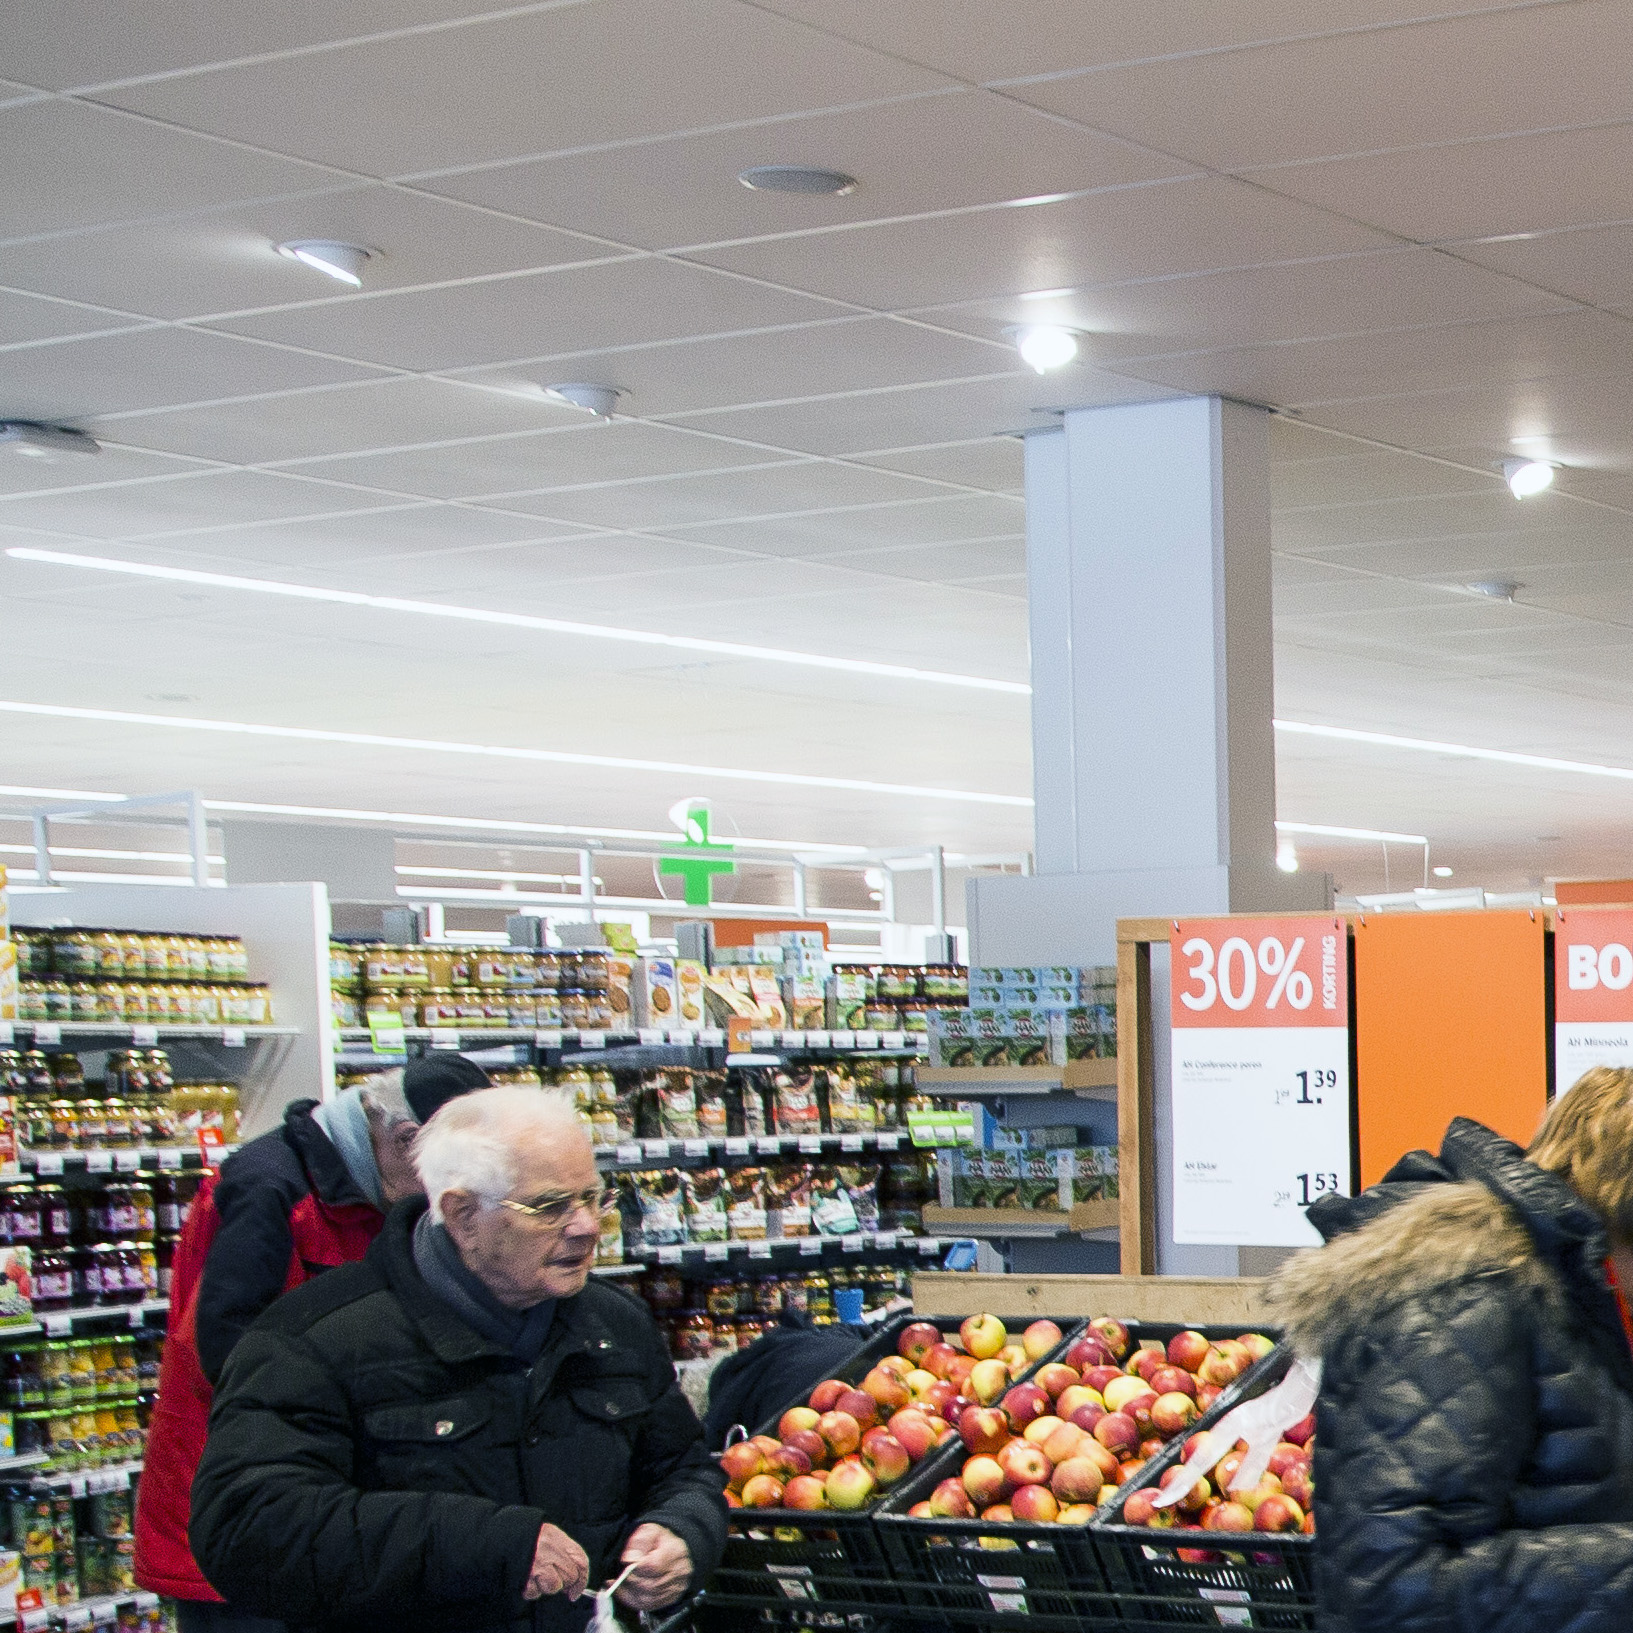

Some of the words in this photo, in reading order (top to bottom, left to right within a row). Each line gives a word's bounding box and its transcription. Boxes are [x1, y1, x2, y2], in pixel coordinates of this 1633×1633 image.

[1180, 936, 1314, 1011] 30%
[1322, 935, 1337, 1010] KORTING
[1296, 1070, 1337, 1104] 1.39
